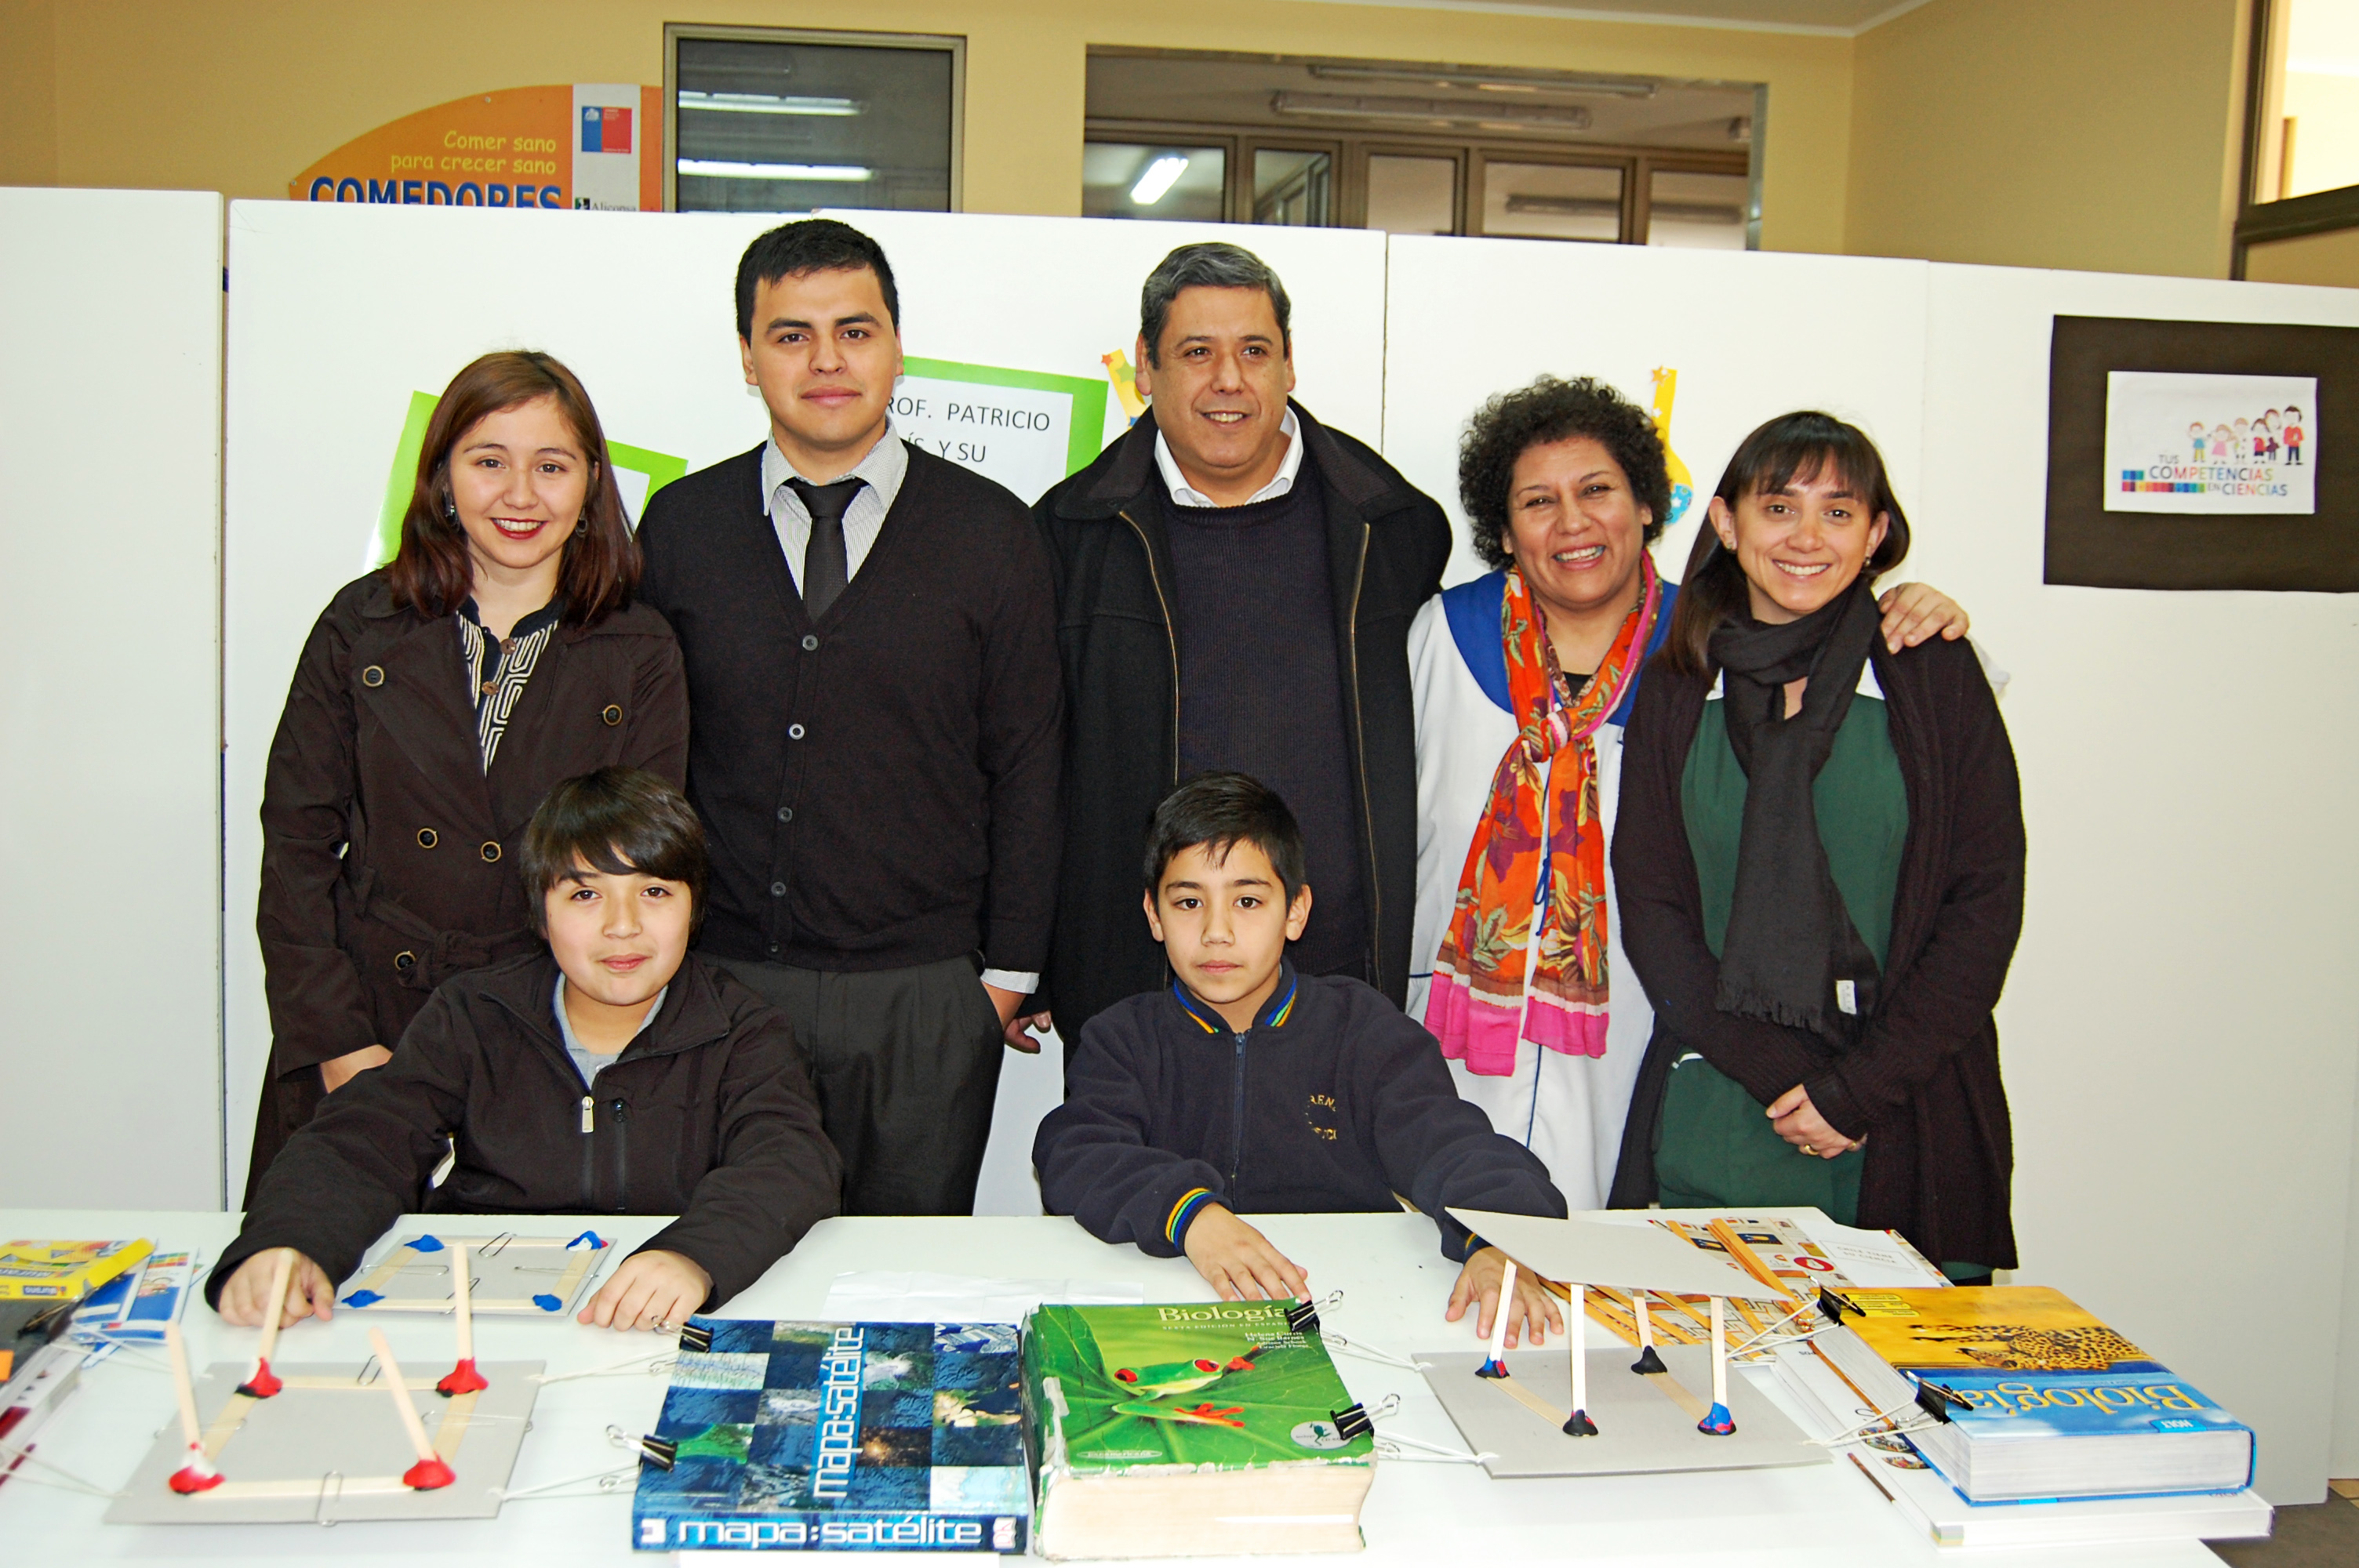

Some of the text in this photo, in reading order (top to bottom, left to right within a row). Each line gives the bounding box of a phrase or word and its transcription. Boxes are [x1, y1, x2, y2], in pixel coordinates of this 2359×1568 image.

[443, 130, 556, 153] Comer sano
[391, 154, 556, 175] para crecer sano
[307, 176, 562, 209] COMEDORES
[888, 396, 1050, 431] ROF. PATRICIO
[939, 440, 951, 459] Y
[957, 442, 987, 463] SU
[2159, 454, 2179, 464] TUS
[2149, 466, 2273, 481] COMPETENCIAS
[2222, 483, 2288, 496] CIENCIAS
[1158, 1305, 1286, 1323] Biología
[813, 1327, 864, 1497] mapa:satélite
[678, 1516, 983, 1549] mapa:satélite
